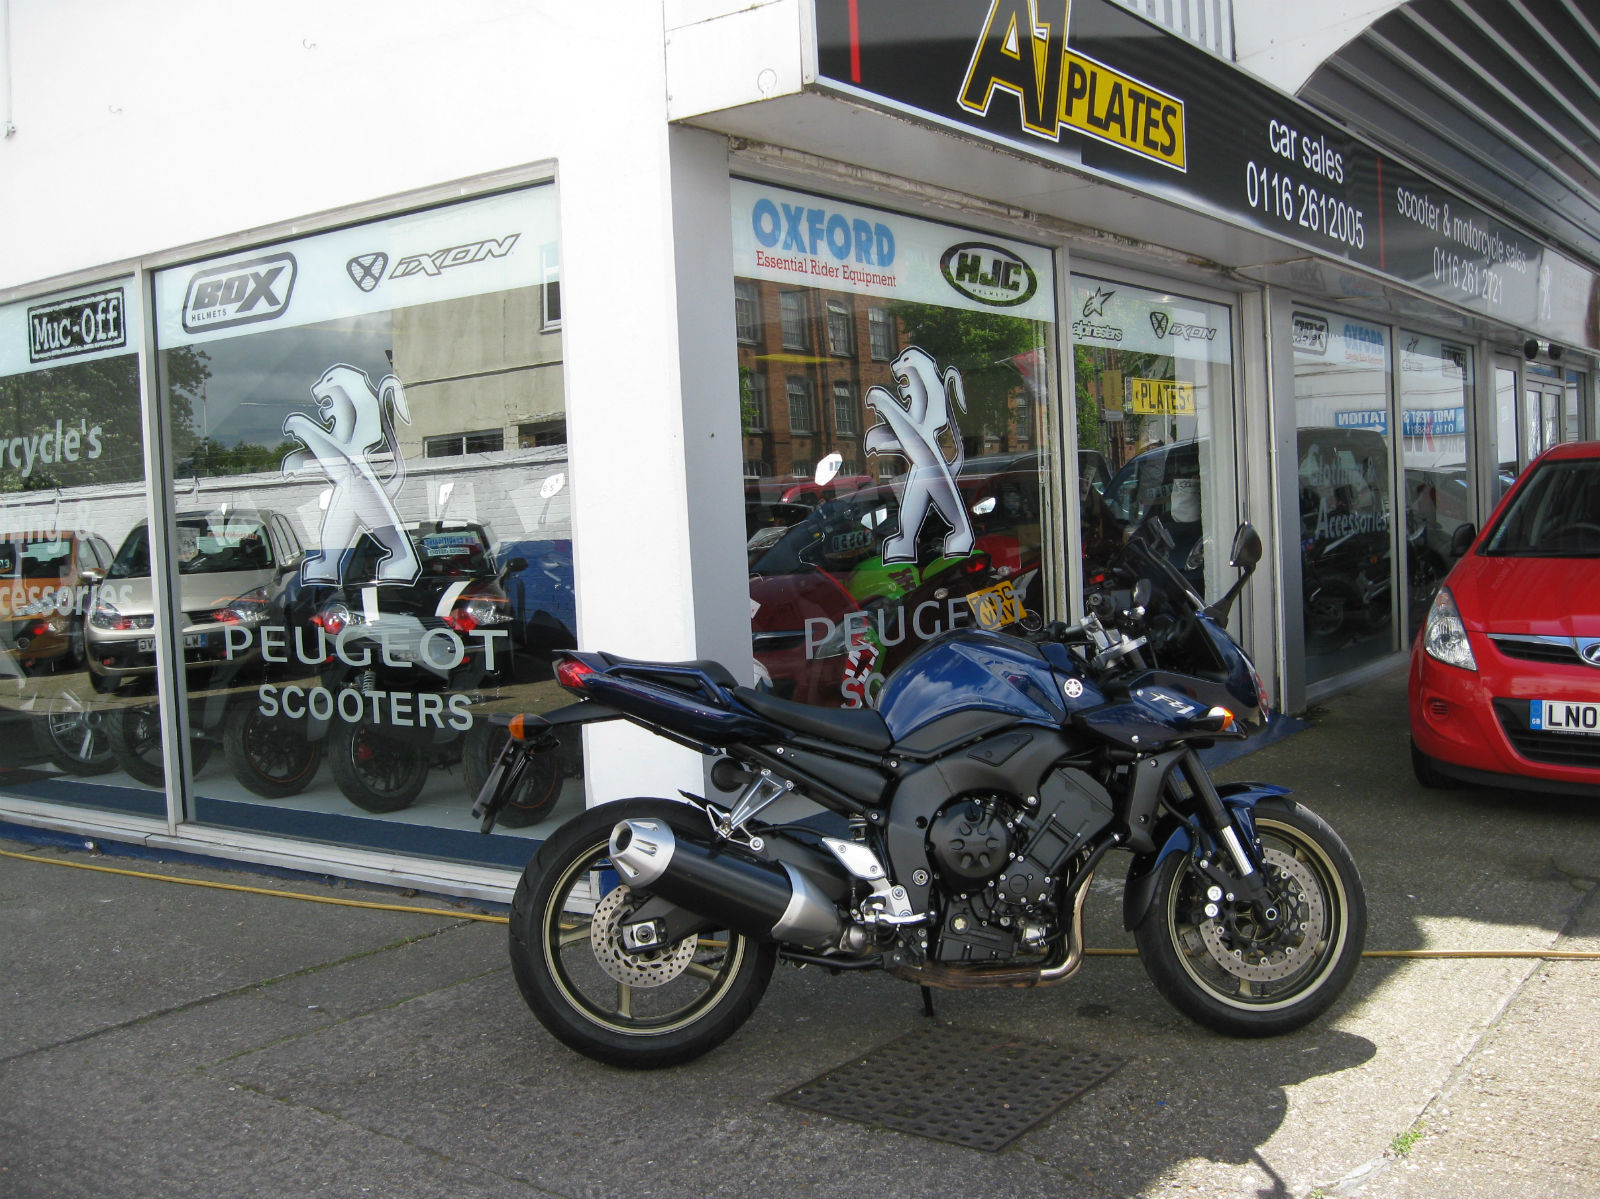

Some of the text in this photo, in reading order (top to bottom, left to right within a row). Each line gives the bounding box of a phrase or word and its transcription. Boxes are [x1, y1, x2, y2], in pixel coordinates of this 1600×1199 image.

[1065, 60, 1177, 157] PLATES
[1269, 119, 1344, 184] car sales
[1246, 161, 1364, 249] 0116 2612005
[752, 198, 896, 268] OXFORD
[1397, 187, 1526, 275] scooter & motorcycle sales
[192, 266, 287, 313] BOX
[756, 250, 897, 287] Essential Rider Equipment
[955, 252, 1022, 292] HJC
[1433, 246, 1503, 304] 0116 261 2721
[33, 299, 119, 350] Muc-Off
[192, 309, 227, 322] HELMETS
[1141, 383, 1186, 410] PLATES
[224, 625, 509, 671] PEUGEOT
[258, 683, 474, 731] SCOOTERS
